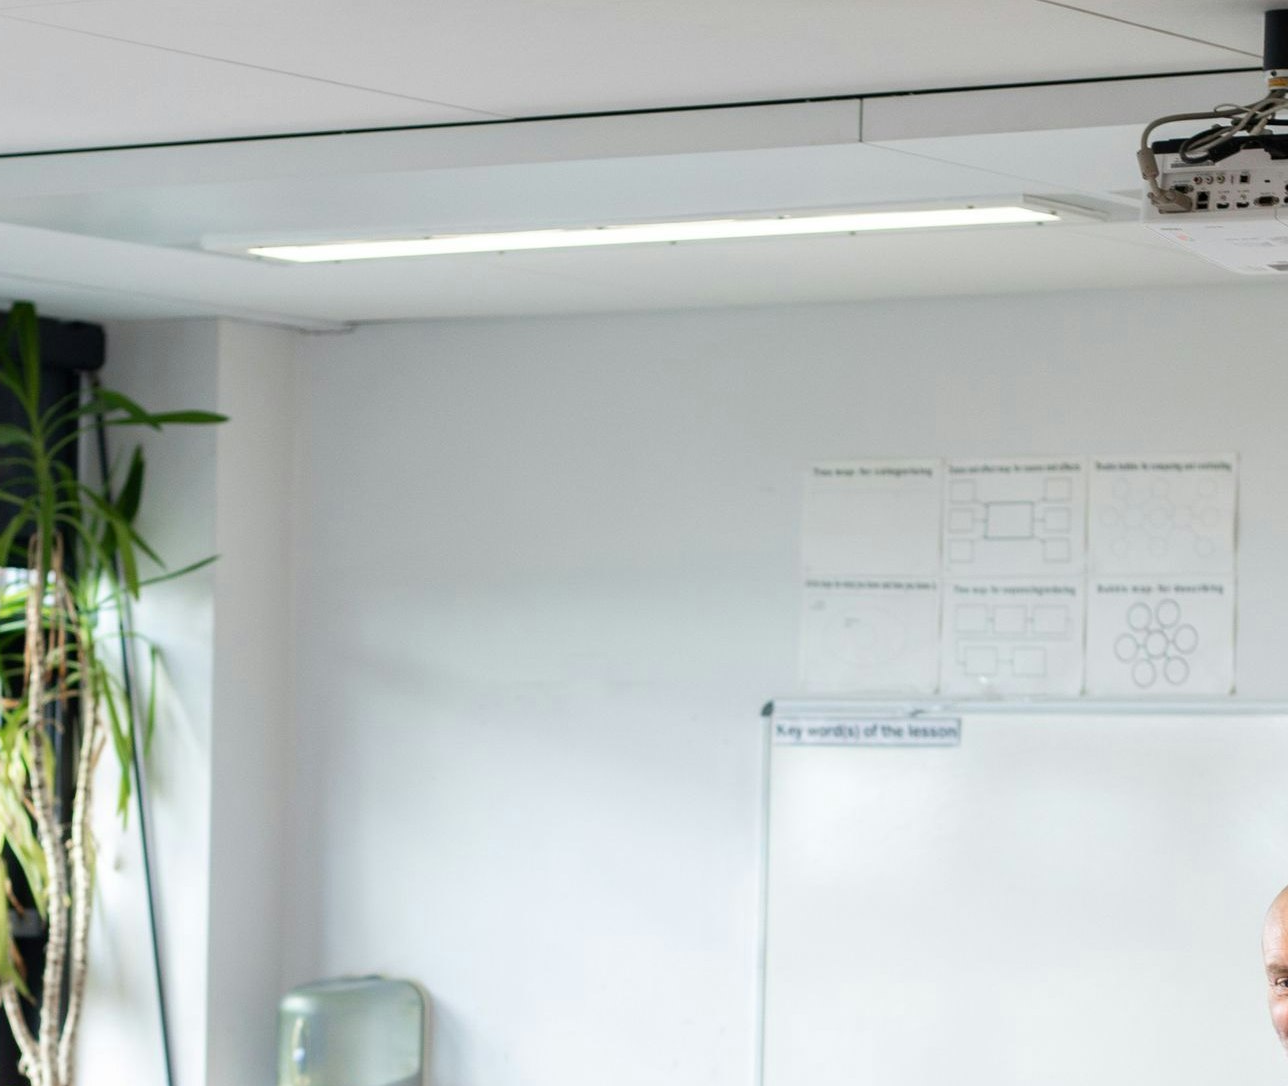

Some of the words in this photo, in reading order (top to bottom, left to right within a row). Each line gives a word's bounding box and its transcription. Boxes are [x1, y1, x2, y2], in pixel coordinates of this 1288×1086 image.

[775, 723, 803, 741] Key
[807, 722, 860, 741] word(s)
[862, 723, 879, 738] of
[880, 723, 904, 738] the
[907, 723, 958, 739] lesson
